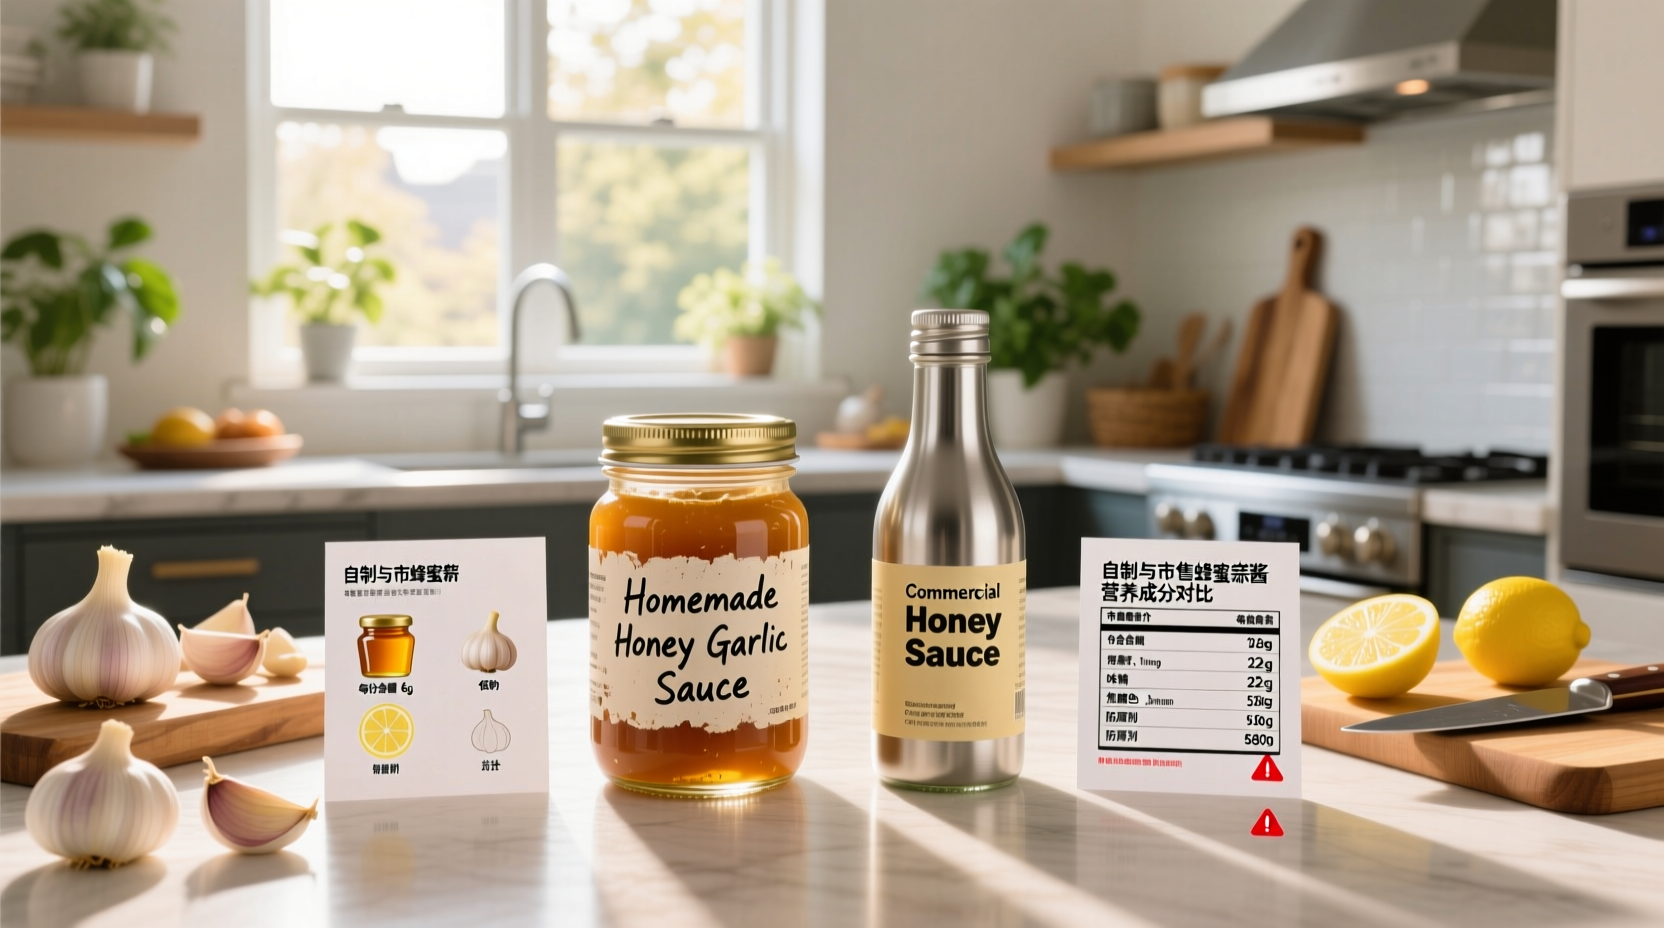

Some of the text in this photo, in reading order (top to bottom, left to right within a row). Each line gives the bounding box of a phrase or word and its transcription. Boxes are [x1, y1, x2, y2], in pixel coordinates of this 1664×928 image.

[624, 574, 778, 616] Homemade
[906, 583, 999, 600] Commercial
[1101, 583, 1213, 603] 营养成分对比
[906, 605, 1001, 641] Honey
[615, 622, 787, 672] Honey Garlic
[905, 638, 1000, 667] Sauce
[1248, 657, 1272, 673] 22g
[401, 682, 413, 695] 6g
[655, 668, 749, 705] Sauce
[1248, 676, 1272, 692] 22g
